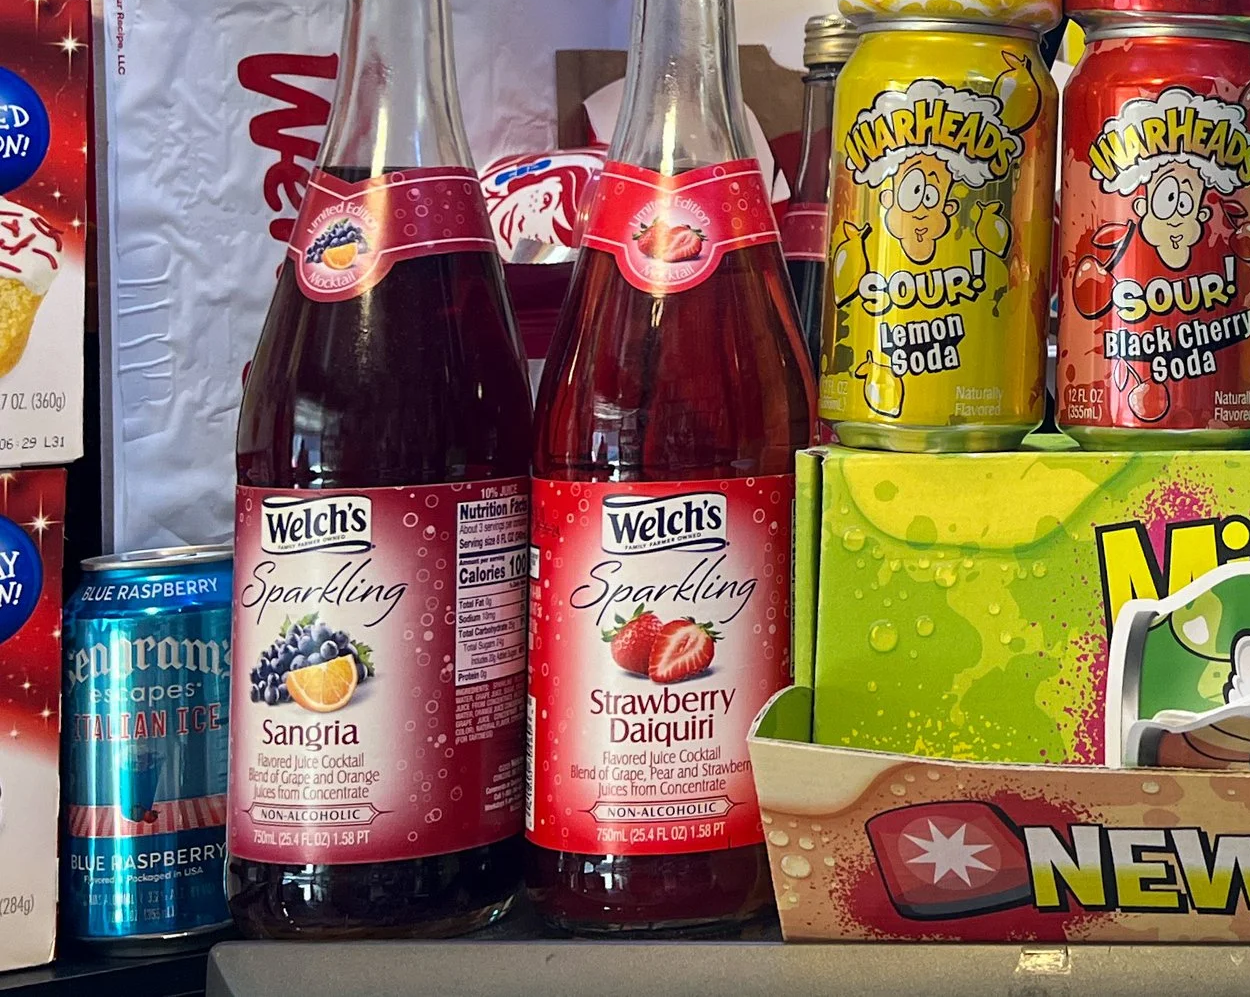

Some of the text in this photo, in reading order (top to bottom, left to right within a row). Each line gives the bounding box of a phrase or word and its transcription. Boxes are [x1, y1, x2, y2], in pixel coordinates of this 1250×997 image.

[117, 55, 126, 75] LLC
[844, 99, 1019, 176] WARHEADS
[307, 201, 344, 234] Limited
[308, 270, 356, 289] Mocktail
[858, 249, 986, 316] SOUR!
[1112, 256, 1236, 322] SOUR!
[879, 313, 964, 351] Lemon
[1104, 326, 1171, 358] Black
[891, 342, 960, 377] Soda
[1151, 350, 1217, 383] Soda
[31, 392, 66, 412] (360g)
[44, 436, 65, 448] L31
[265, 502, 367, 544] Welch's
[459, 500, 507, 521] Nutrition
[607, 500, 722, 545] Welch's
[81, 578, 218, 602] BLUE RASPBERRY
[459, 565, 506, 585] Calories
[570, 554, 758, 625] Sparkling
[241, 558, 409, 628] Sparkling
[89, 682, 197, 704] escapes
[590, 686, 736, 716] Strawberry
[74, 702, 221, 742] ITALIAN ICE
[262, 719, 360, 751] Sangria
[610, 715, 714, 748] Daiquiri
[603, 746, 721, 767] Flavored Juice Cocktail
[260, 807, 361, 822] NON-ALCOHOLIC
[607, 801, 718, 818] NON-ALCOHOLIC
[71, 842, 227, 871] BLUE RASPBERRY
